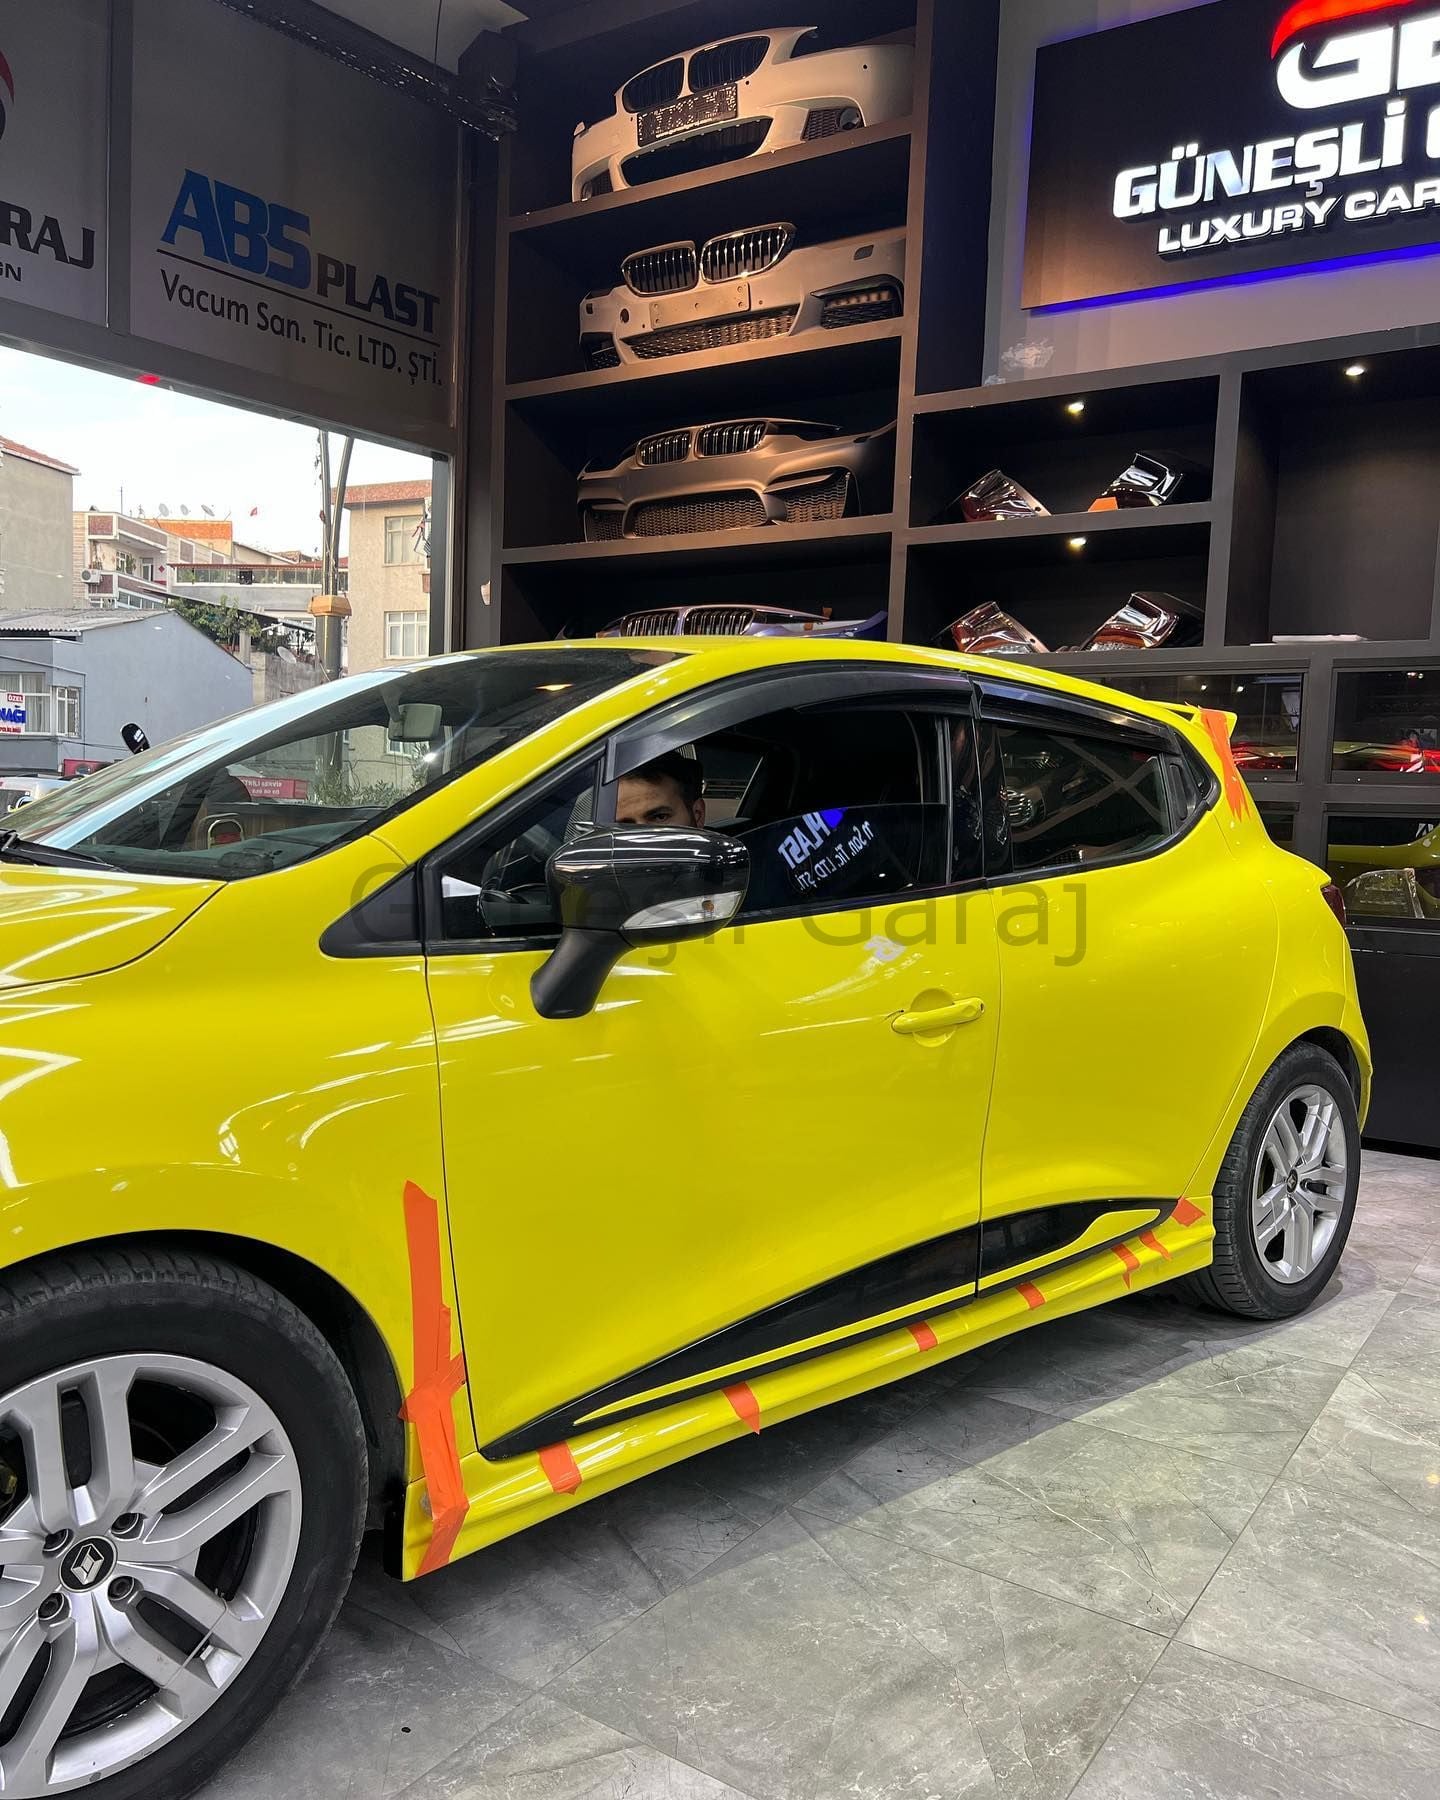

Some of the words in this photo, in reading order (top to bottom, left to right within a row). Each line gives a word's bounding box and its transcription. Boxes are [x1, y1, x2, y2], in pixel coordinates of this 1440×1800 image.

[1112, 99, 1407, 218] GÜNEŞLİ
[160, 168, 312, 290] ABS
[316, 253, 441, 334] PLAST
[1157, 195, 1338, 254] LUXURY
[160, 268, 249, 326] Vacum
[256, 301, 307, 344] San.
[313, 319, 351, 358] Tic.
[358, 334, 402, 374] LTD.
[408, 350, 443, 387] ŞTİ.
